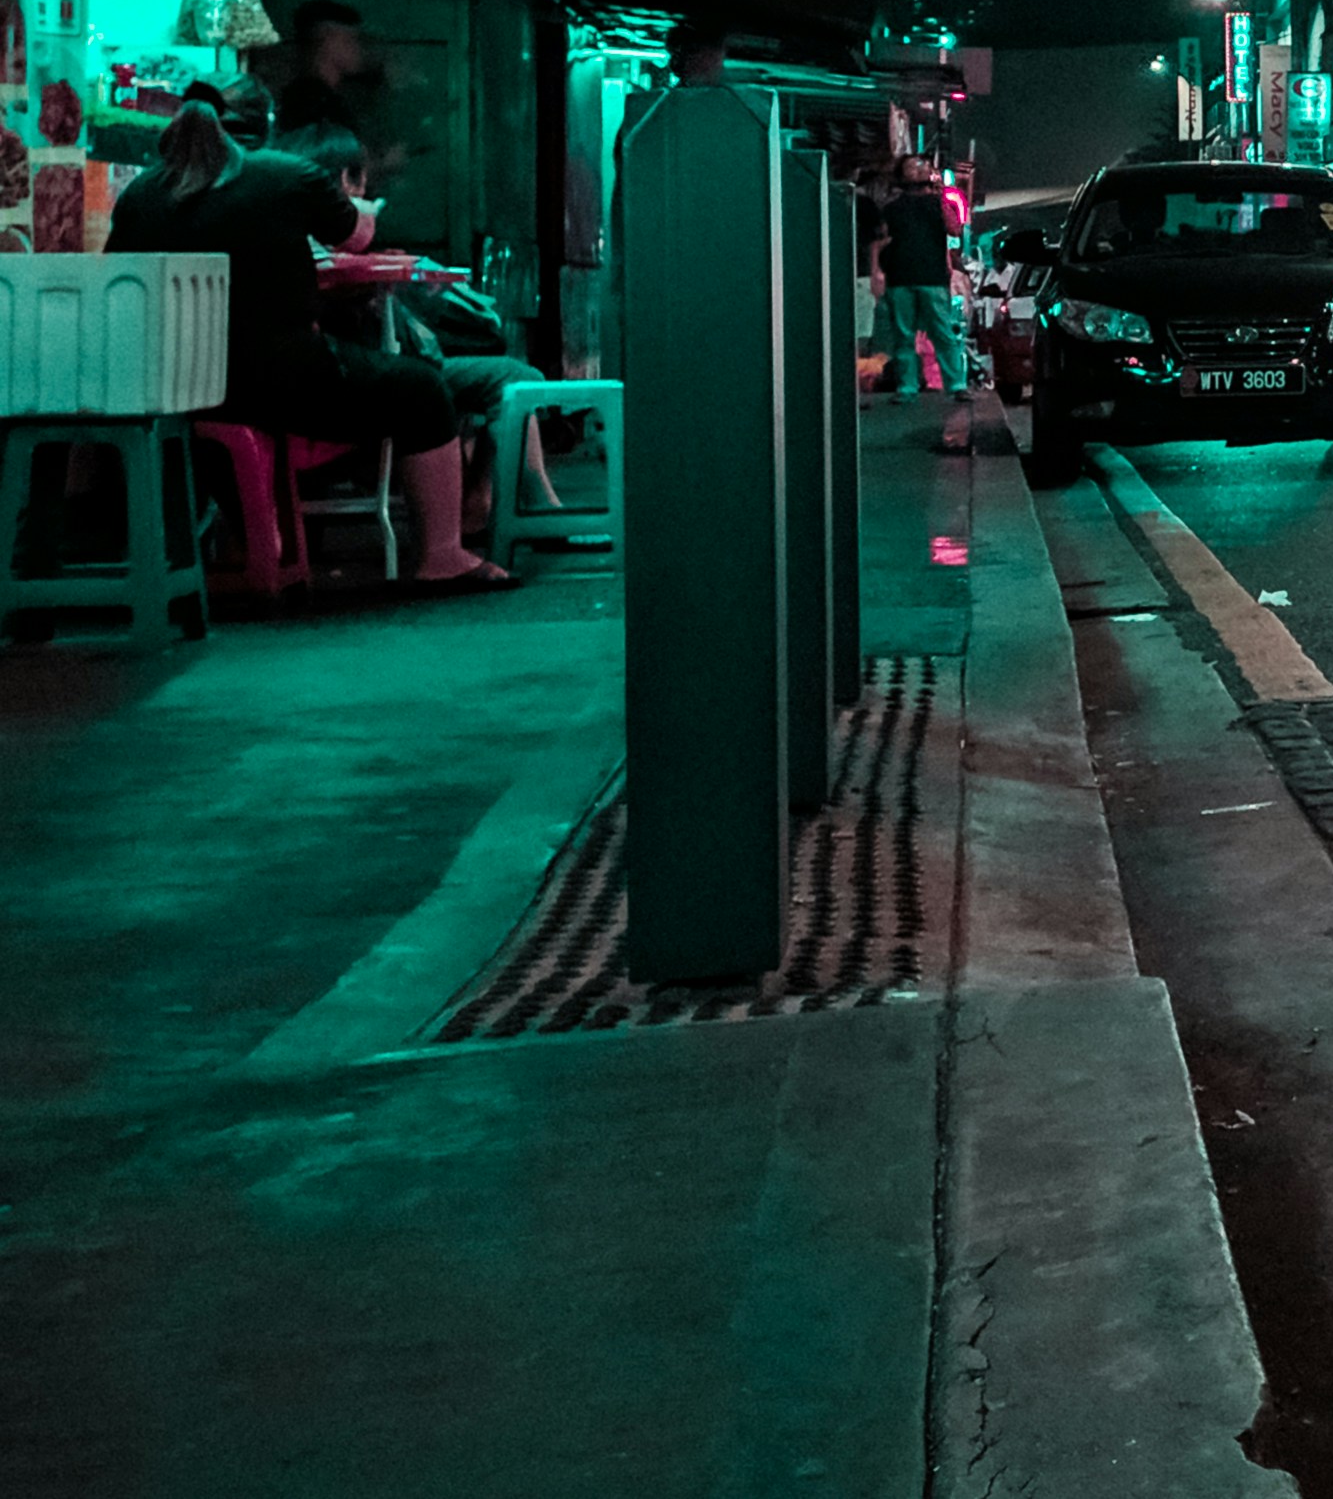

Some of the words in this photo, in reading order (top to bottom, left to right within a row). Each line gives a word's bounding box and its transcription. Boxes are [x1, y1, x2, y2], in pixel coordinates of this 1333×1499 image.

[1233, 14, 1251, 100] HOTEL
[1200, 370, 1234, 391] WTV
[1242, 369, 1286, 390] 3603
